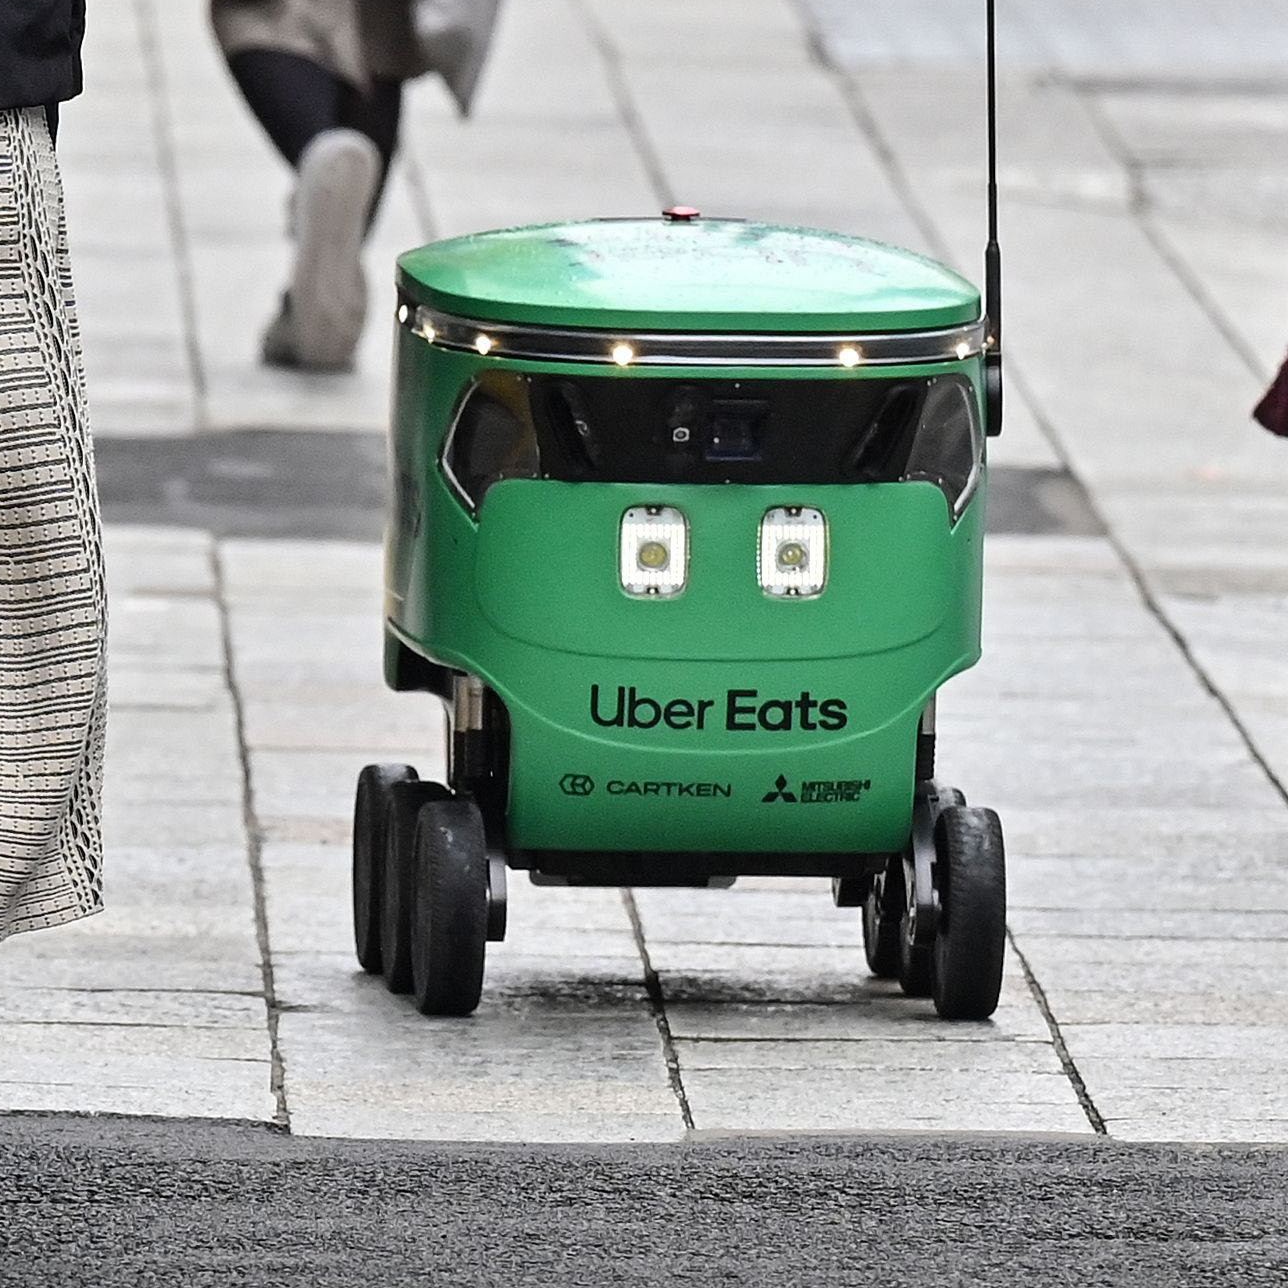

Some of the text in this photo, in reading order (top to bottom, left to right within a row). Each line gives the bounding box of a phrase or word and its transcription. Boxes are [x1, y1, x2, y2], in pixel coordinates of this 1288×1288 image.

[590, 683, 848, 731] Uber Eats
[606, 780, 732, 798] CARTKEN
